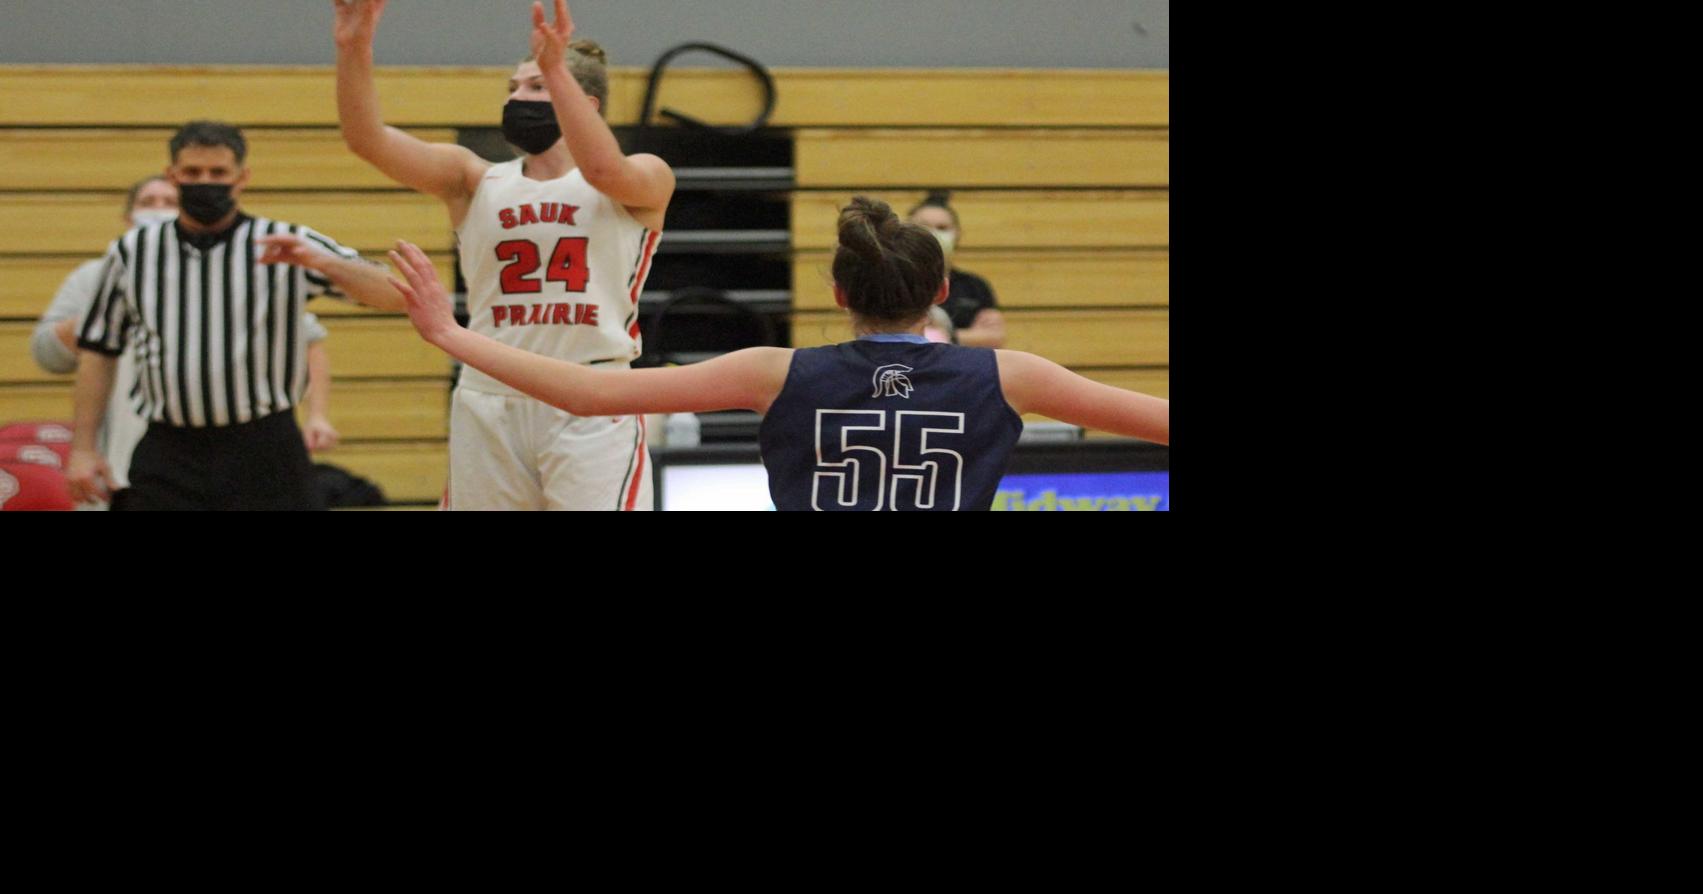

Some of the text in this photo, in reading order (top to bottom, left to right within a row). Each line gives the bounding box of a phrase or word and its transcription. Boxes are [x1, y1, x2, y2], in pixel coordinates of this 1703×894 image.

[498, 202, 580, 229] SAUK
[494, 236, 590, 294] 24
[491, 303, 600, 328] PRAIRIE
[811, 408, 965, 511] 55
